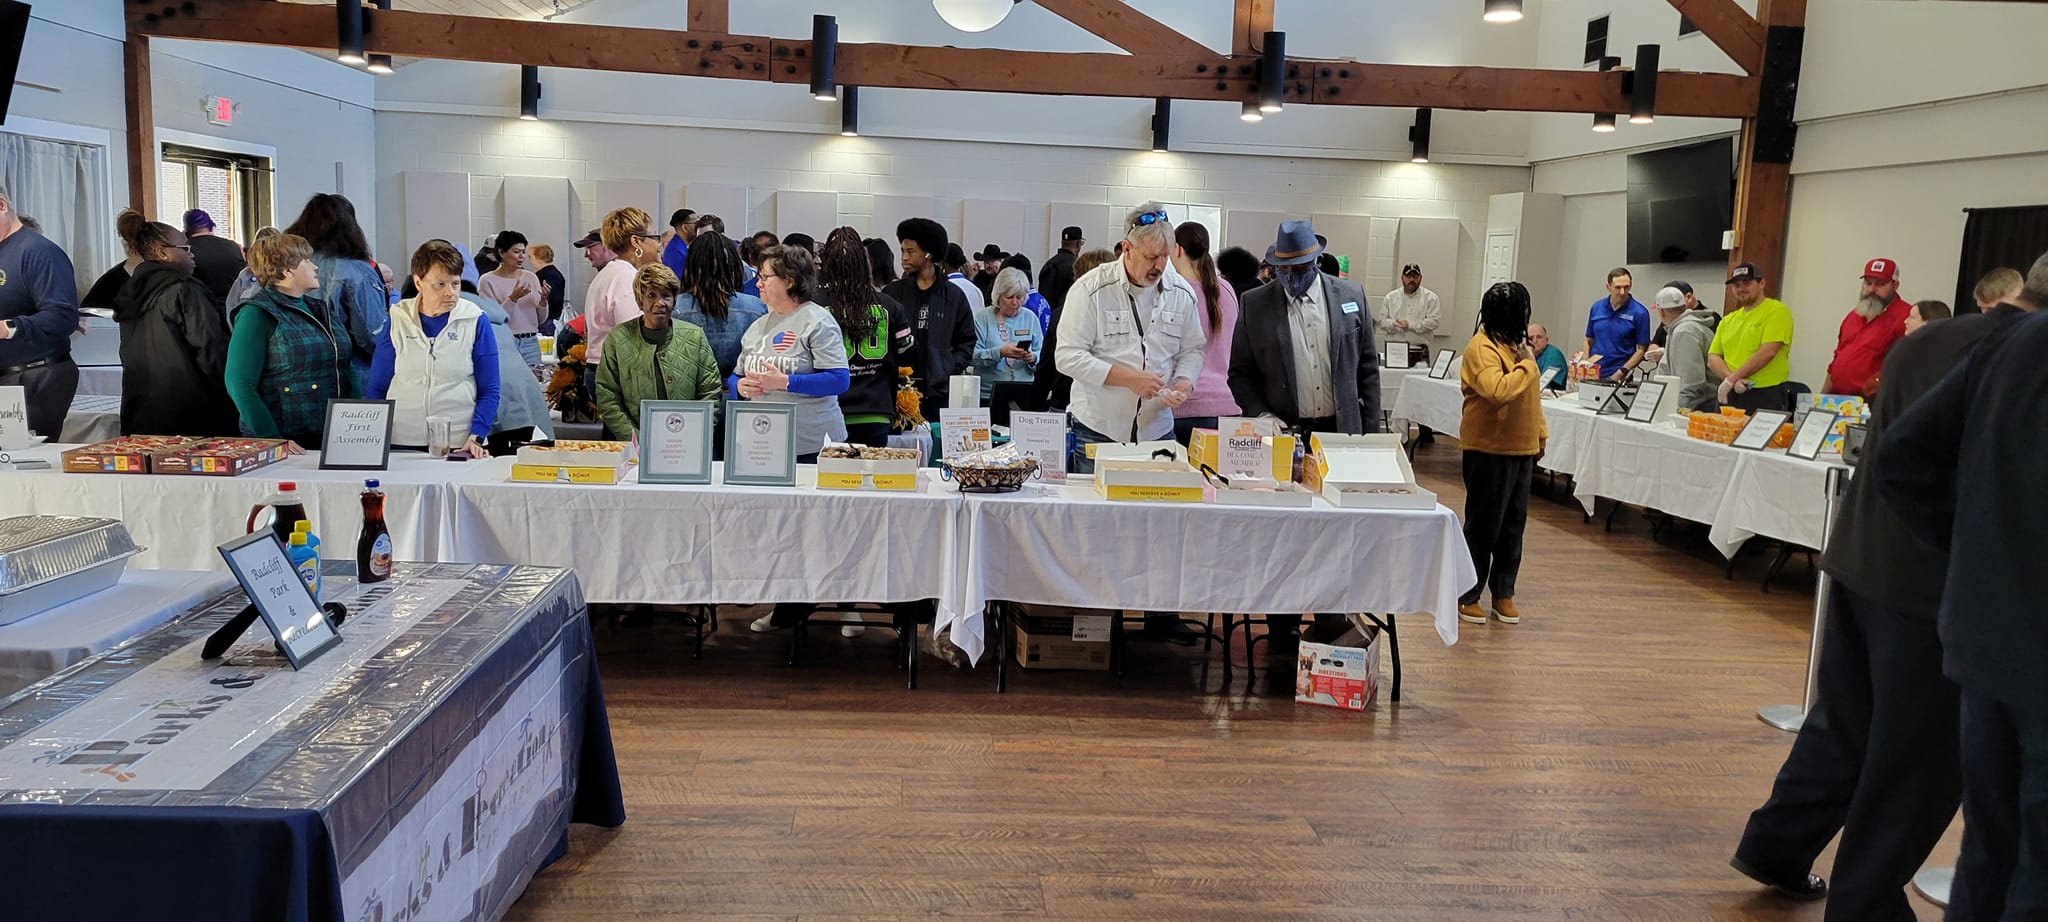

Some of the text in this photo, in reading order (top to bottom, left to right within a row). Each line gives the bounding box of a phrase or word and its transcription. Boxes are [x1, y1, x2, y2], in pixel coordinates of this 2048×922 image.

[340, 410, 381, 421] Radcliff
[1018, 416, 1060, 425] Dog Treats
[345, 423, 371, 432] First
[333, 434, 381, 446] Assembly
[1229, 438, 1262, 447] Radcliff
[251, 556, 283, 580] Radcliff
[269, 580, 290, 599] Park
[288, 605, 297, 617] &
[58, 694, 233, 766] Parks
